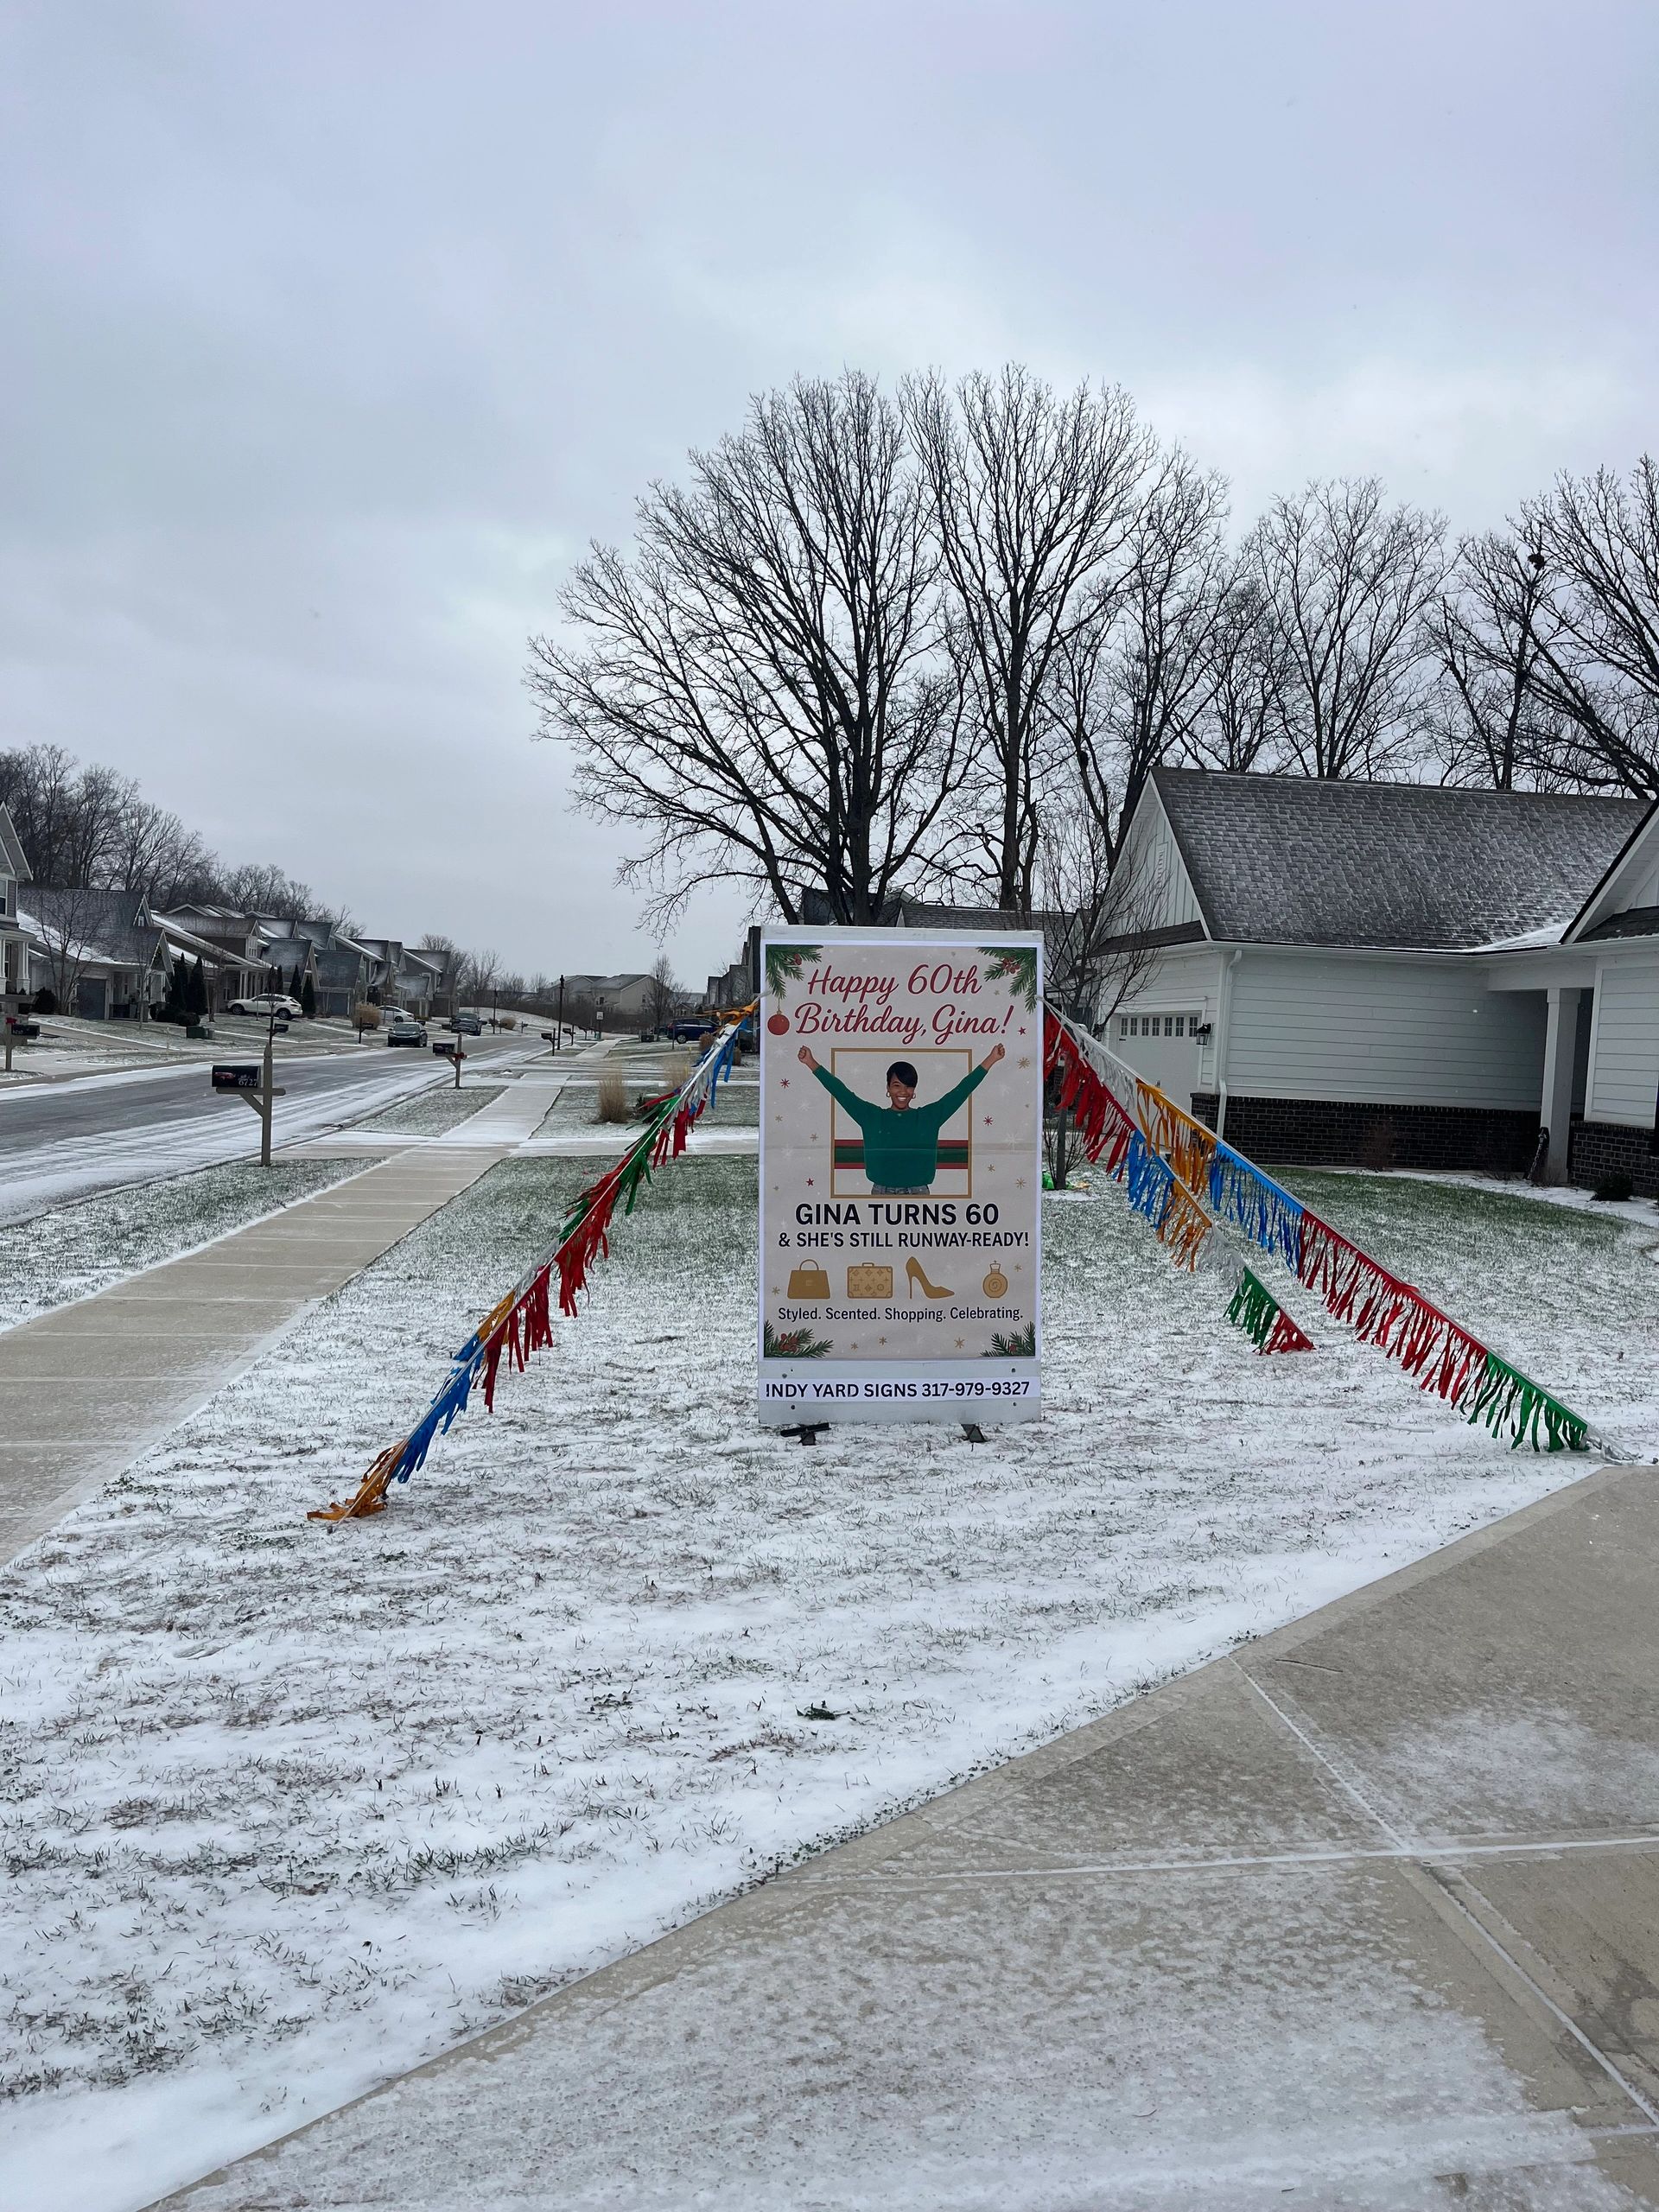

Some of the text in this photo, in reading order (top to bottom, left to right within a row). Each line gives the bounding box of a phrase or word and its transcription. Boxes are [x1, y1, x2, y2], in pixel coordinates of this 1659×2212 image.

[808, 963, 982, 1005] Happy 60th
[794, 1002, 1014, 1045] Birthday, Gina!
[795, 1203, 1000, 1225] GINA TURNS 60
[778, 1231, 1029, 1248] & SHE'S STILL RUNWAY-READY!
[778, 1306, 1024, 1323] Styled. Scented. Shopping. Celebrating.
[766, 1381, 1030, 1398] INDY YARD SIGNS 317-979-9327
